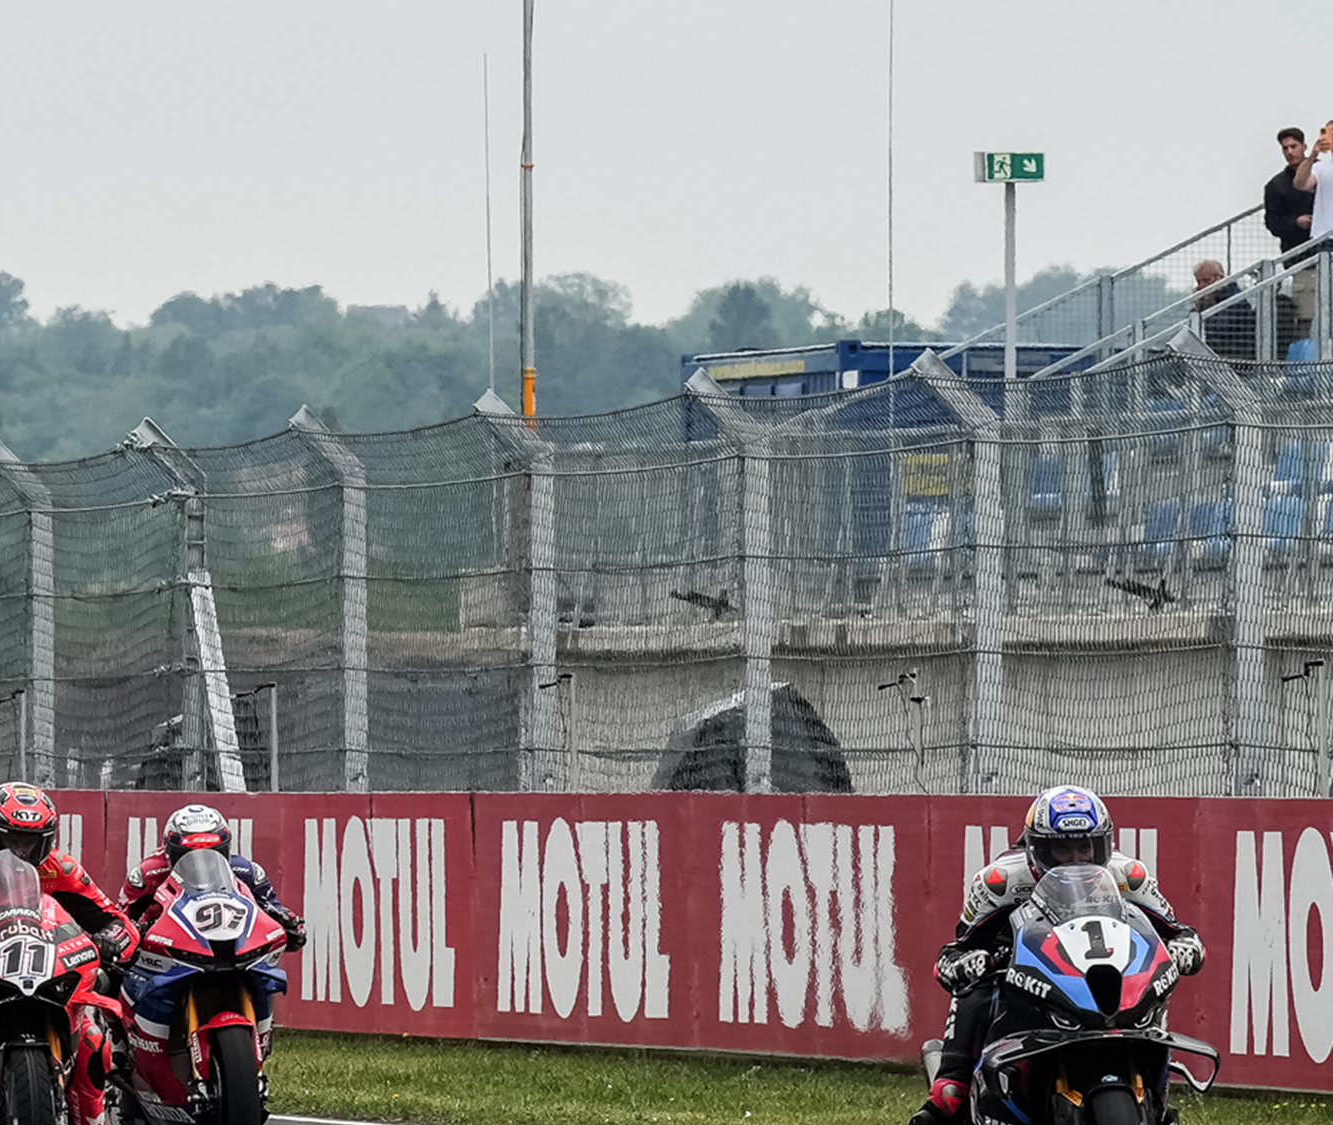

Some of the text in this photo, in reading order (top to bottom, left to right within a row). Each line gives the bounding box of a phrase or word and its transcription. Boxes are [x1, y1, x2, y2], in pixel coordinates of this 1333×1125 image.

[12, 811, 41, 821] KYT
[1062, 819, 1086, 827] SHOEI
[195, 902, 247, 932] 97
[300, 815, 456, 1011] MOTUL
[497, 817, 671, 1023] MOTUL
[719, 818, 913, 1041] MOTUL
[59, 937, 90, 953] ALTEN
[1081, 920, 1114, 959] 1
[0, 938, 49, 978] 11
[63, 949, 96, 966] Lenovo
